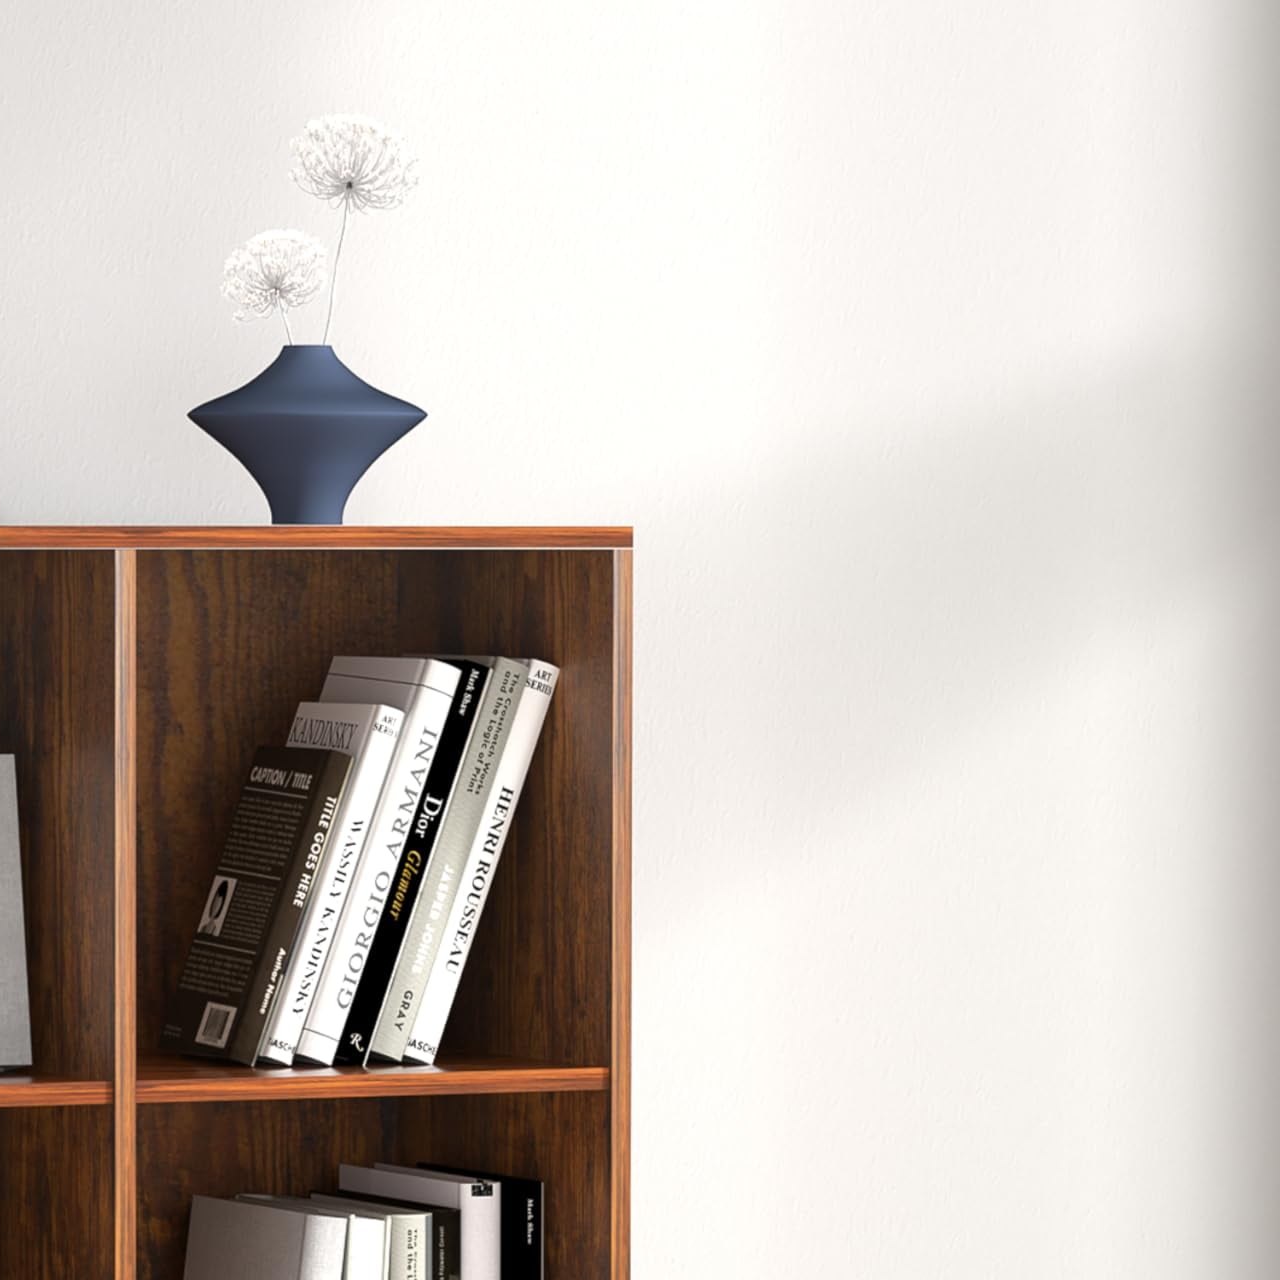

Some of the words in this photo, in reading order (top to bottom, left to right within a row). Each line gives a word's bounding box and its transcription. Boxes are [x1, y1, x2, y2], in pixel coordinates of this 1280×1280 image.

[500, 671, 512, 694] and
[508, 672, 520, 694] The
[534, 670, 552, 682] ART
[492, 697, 504, 715] the
[288, 716, 359, 750] KANDINSKY
[482, 719, 497, 749] Logic
[487, 698, 512, 757] Crosshatch
[250, 766, 285, 786] CAPTION
[292, 772, 313, 790] TITLE
[467, 767, 481, 793] Print
[474, 762, 491, 795] Works
[318, 796, 338, 829] TITLE
[415, 793, 444, 839] Dior
[482, 786, 514, 857] HENRI
[305, 832, 325, 870] GOES
[337, 870, 391, 1010] GIORGIO
[386, 726, 438, 861] ARMANI
[293, 873, 312, 908] HERE
[389, 850, 422, 921] Glamour
[445, 860, 490, 976] ROUSSEAU
[270, 947, 288, 982] Author
[292, 907, 336, 1016] KANDINSKY
[259, 984, 276, 1015] Name
[394, 990, 414, 1032] GRAY
